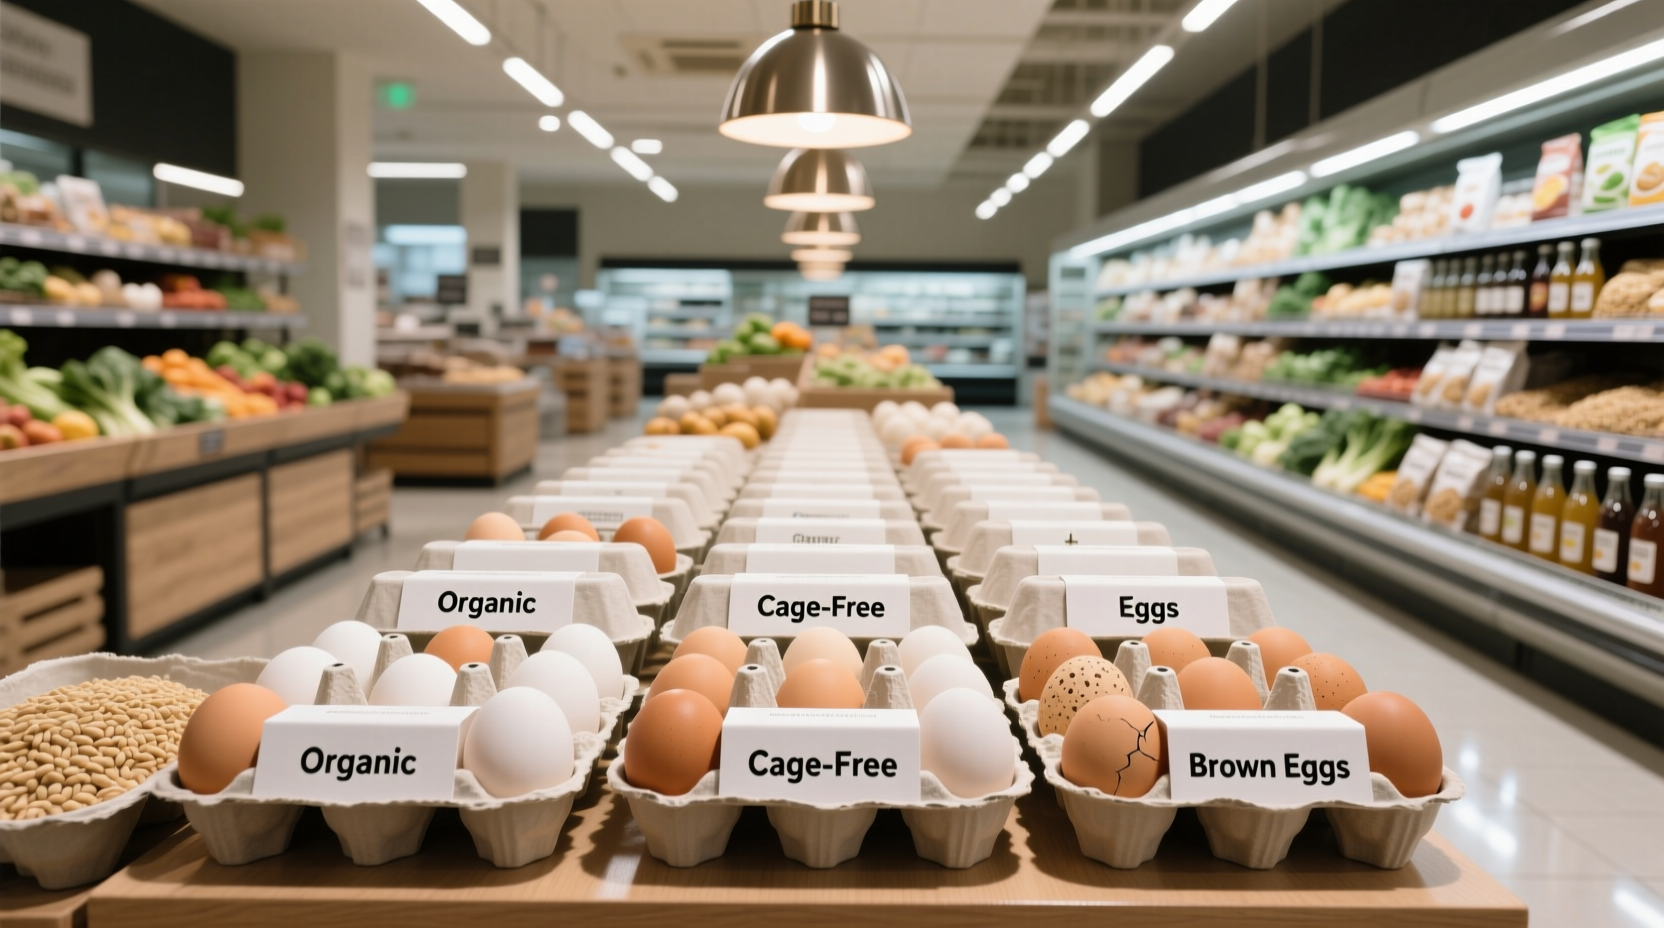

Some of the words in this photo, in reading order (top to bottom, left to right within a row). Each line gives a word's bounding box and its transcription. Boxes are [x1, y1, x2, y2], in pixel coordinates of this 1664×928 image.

[437, 590, 537, 620] Organic
[757, 594, 886, 624] Cage-Free
[1118, 595, 1180, 624] Eggs
[299, 746, 417, 782] Organic
[748, 749, 898, 785] Cage-Free
[1188, 752, 1278, 779] Brown
[1283, 752, 1352, 787] Eggs
